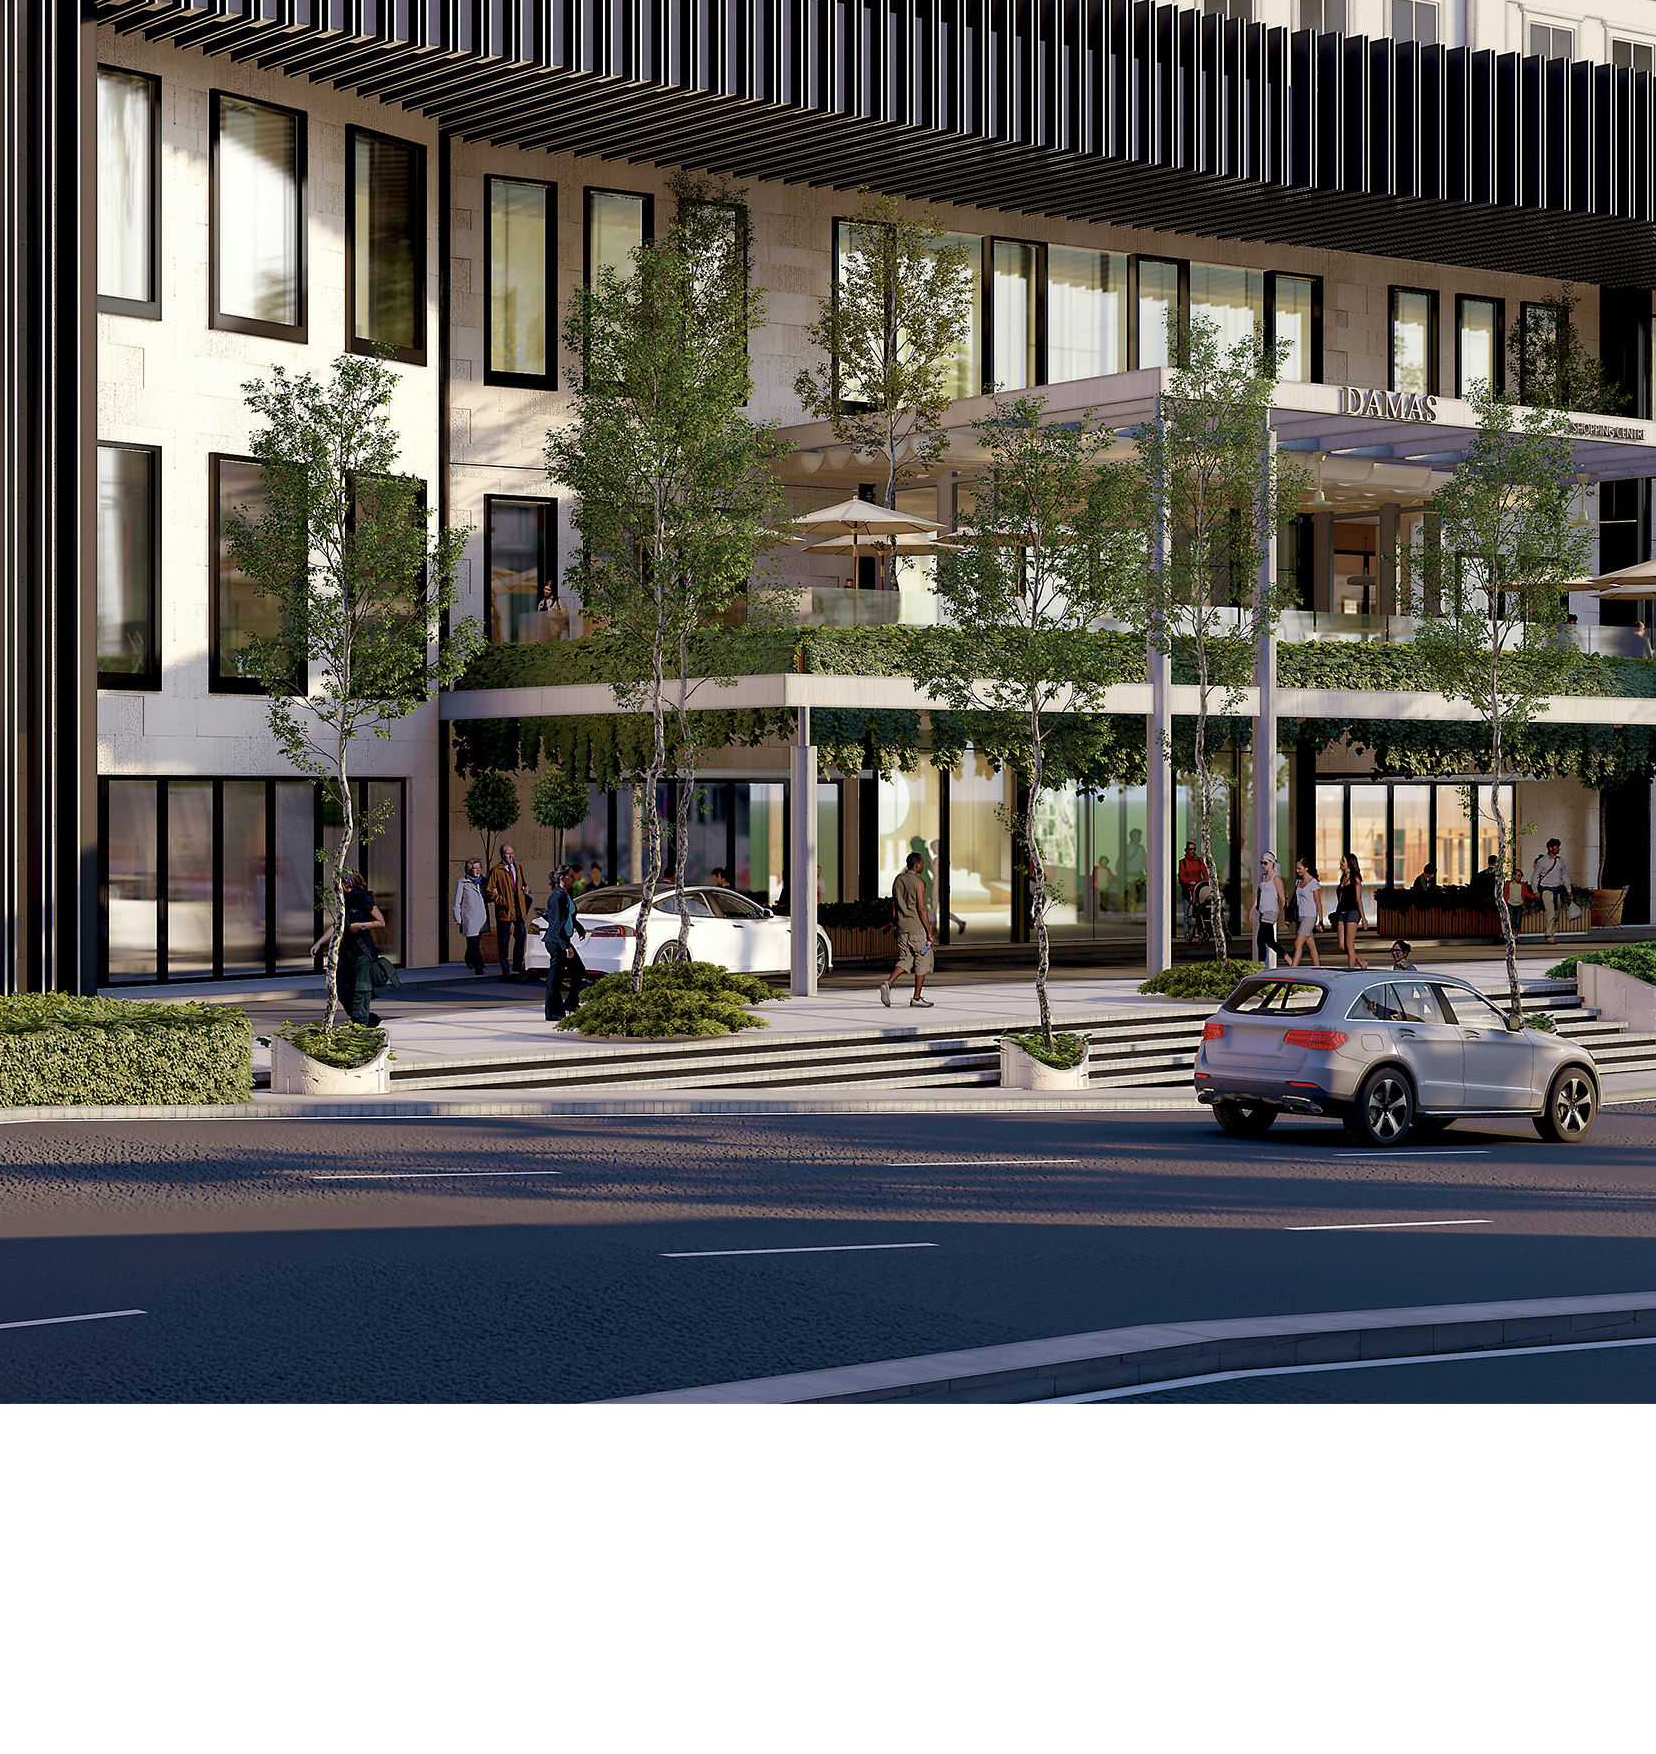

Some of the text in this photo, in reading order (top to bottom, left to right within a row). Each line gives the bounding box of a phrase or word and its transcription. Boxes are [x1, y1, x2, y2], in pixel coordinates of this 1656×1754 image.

[1344, 386, 1438, 422] DAMAS
[1572, 421, 1645, 440] SHOPPING CENTRE
